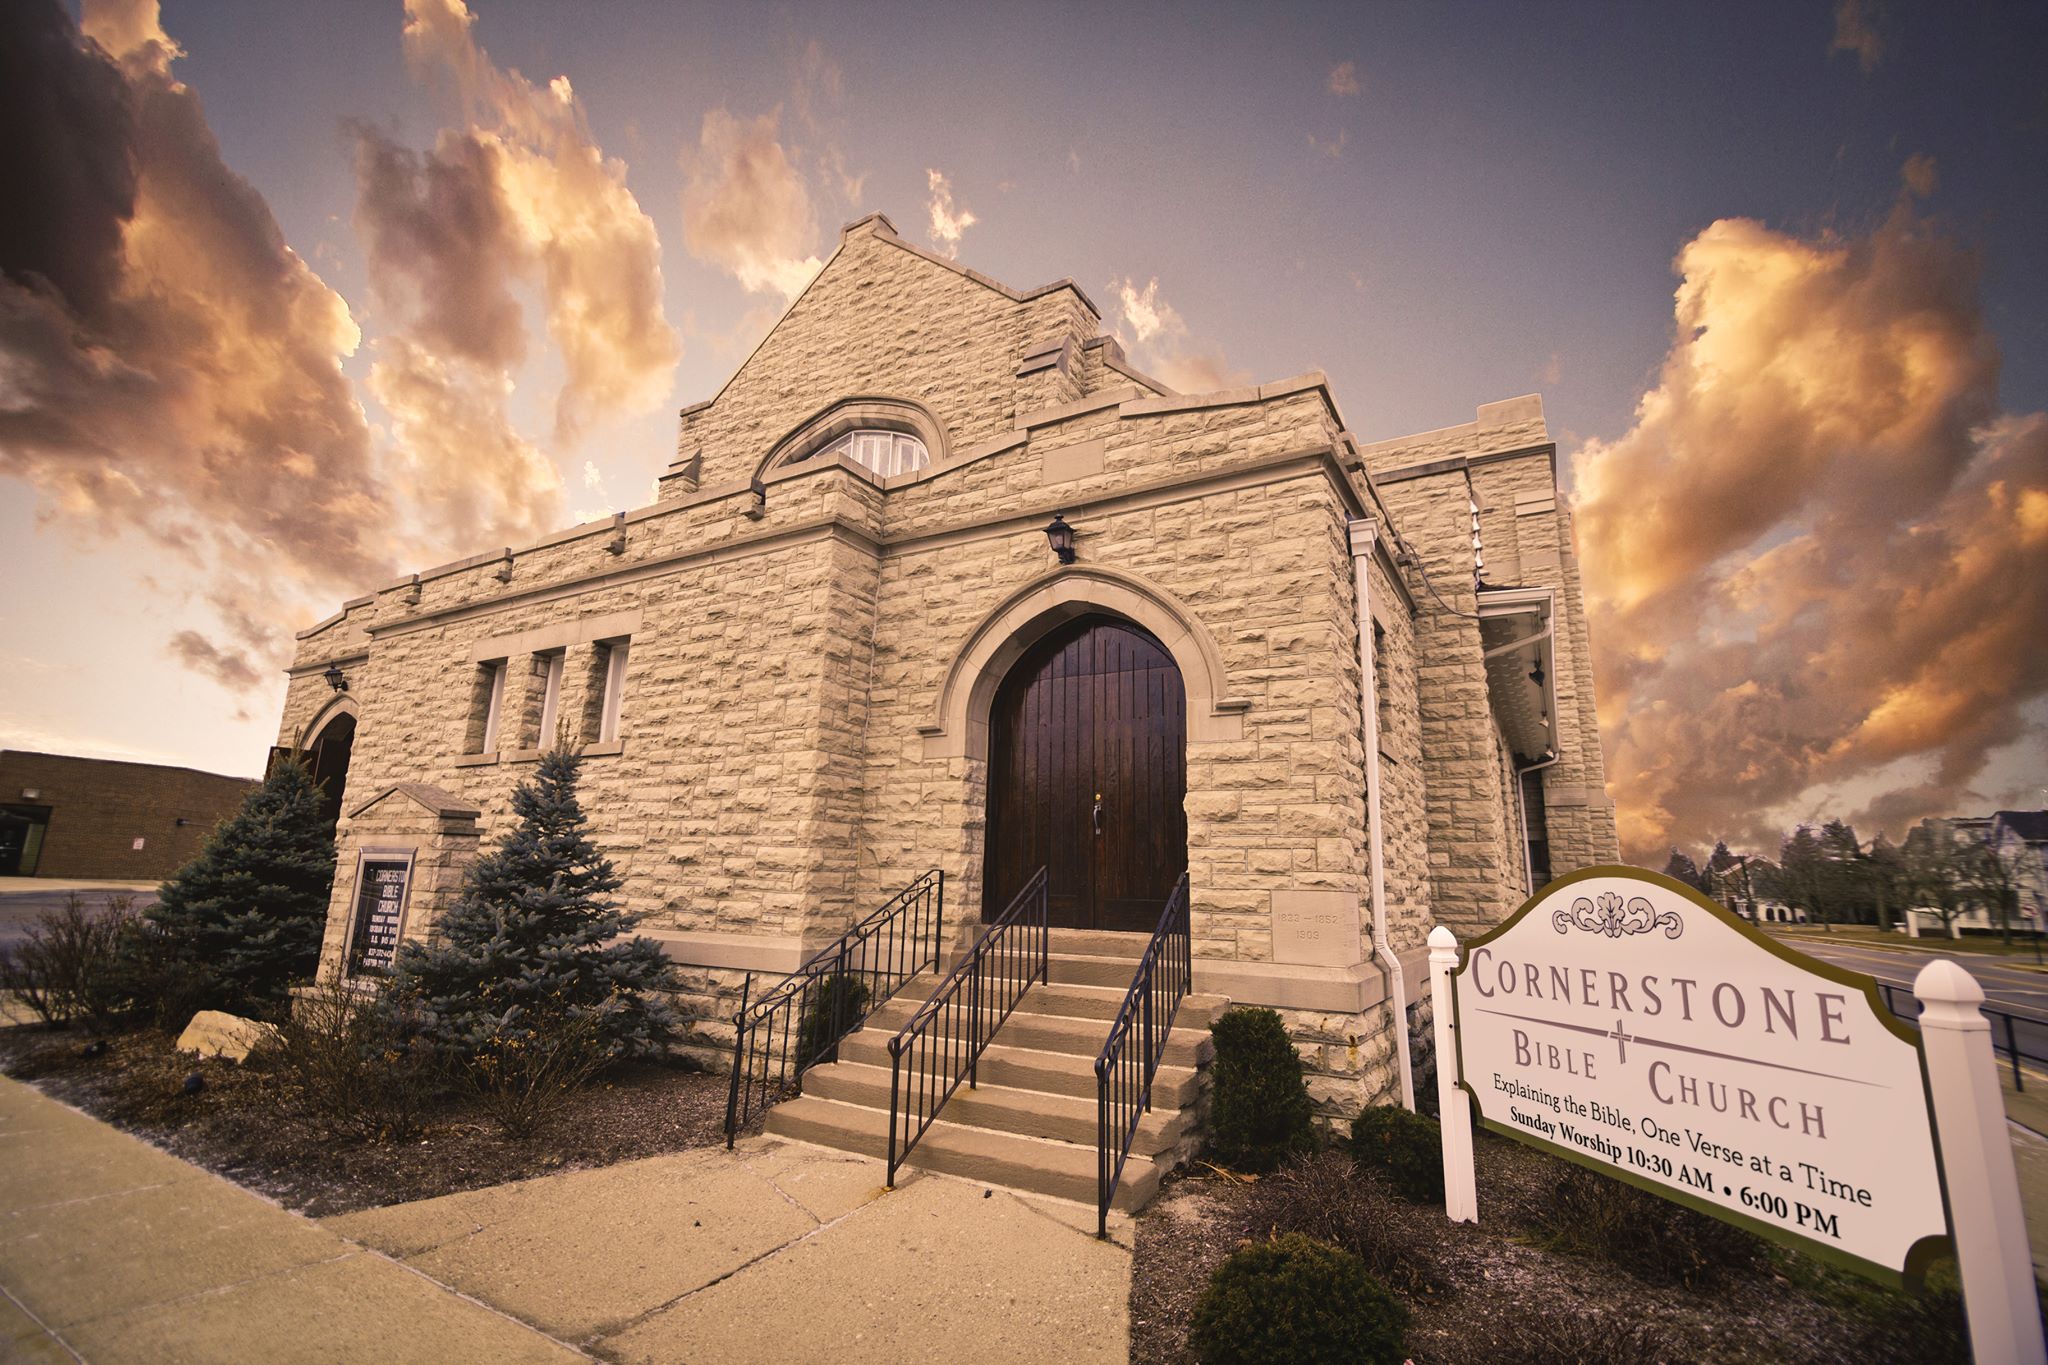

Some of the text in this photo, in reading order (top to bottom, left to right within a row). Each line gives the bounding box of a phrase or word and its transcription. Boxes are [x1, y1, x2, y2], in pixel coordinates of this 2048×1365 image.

[378, 900, 399, 913] CHURCH
[382, 885, 399, 898] BIBLE
[1472, 948, 1850, 1045] CORNERSTONE
[1512, 1029, 1826, 1139] BIBLE CHURCH
[1493, 1073, 1872, 1207] Explaining the Bible, One Verse at a Time
[1511, 1106, 1842, 1239] Sunday Worship 10:30 AM 6:00 PM
